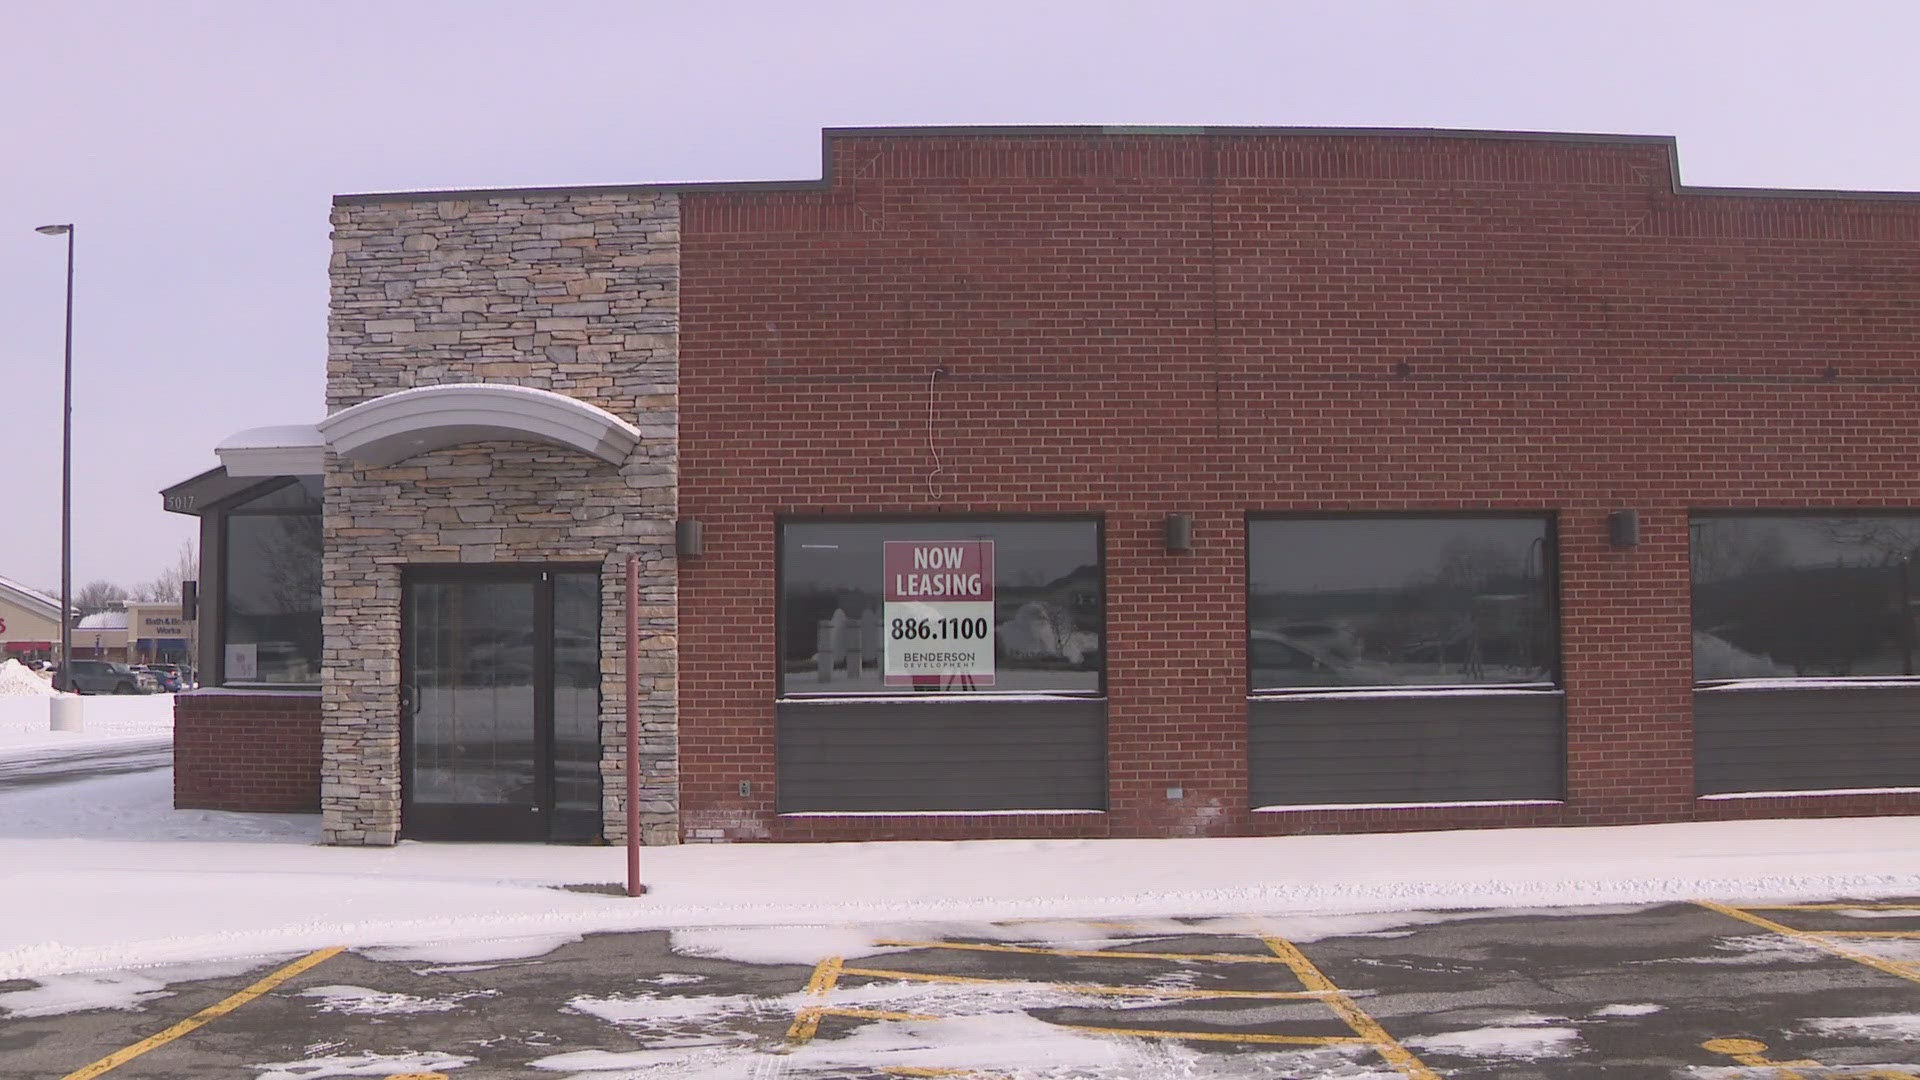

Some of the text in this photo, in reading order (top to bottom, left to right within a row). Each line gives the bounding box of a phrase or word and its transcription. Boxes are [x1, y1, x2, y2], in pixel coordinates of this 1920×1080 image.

[168, 496, 194, 509] 5017
[914, 547, 964, 569] NOW
[896, 573, 982, 596] LEASING
[891, 617, 988, 640] 886.1100
[904, 652, 975, 662] BENDERSON
